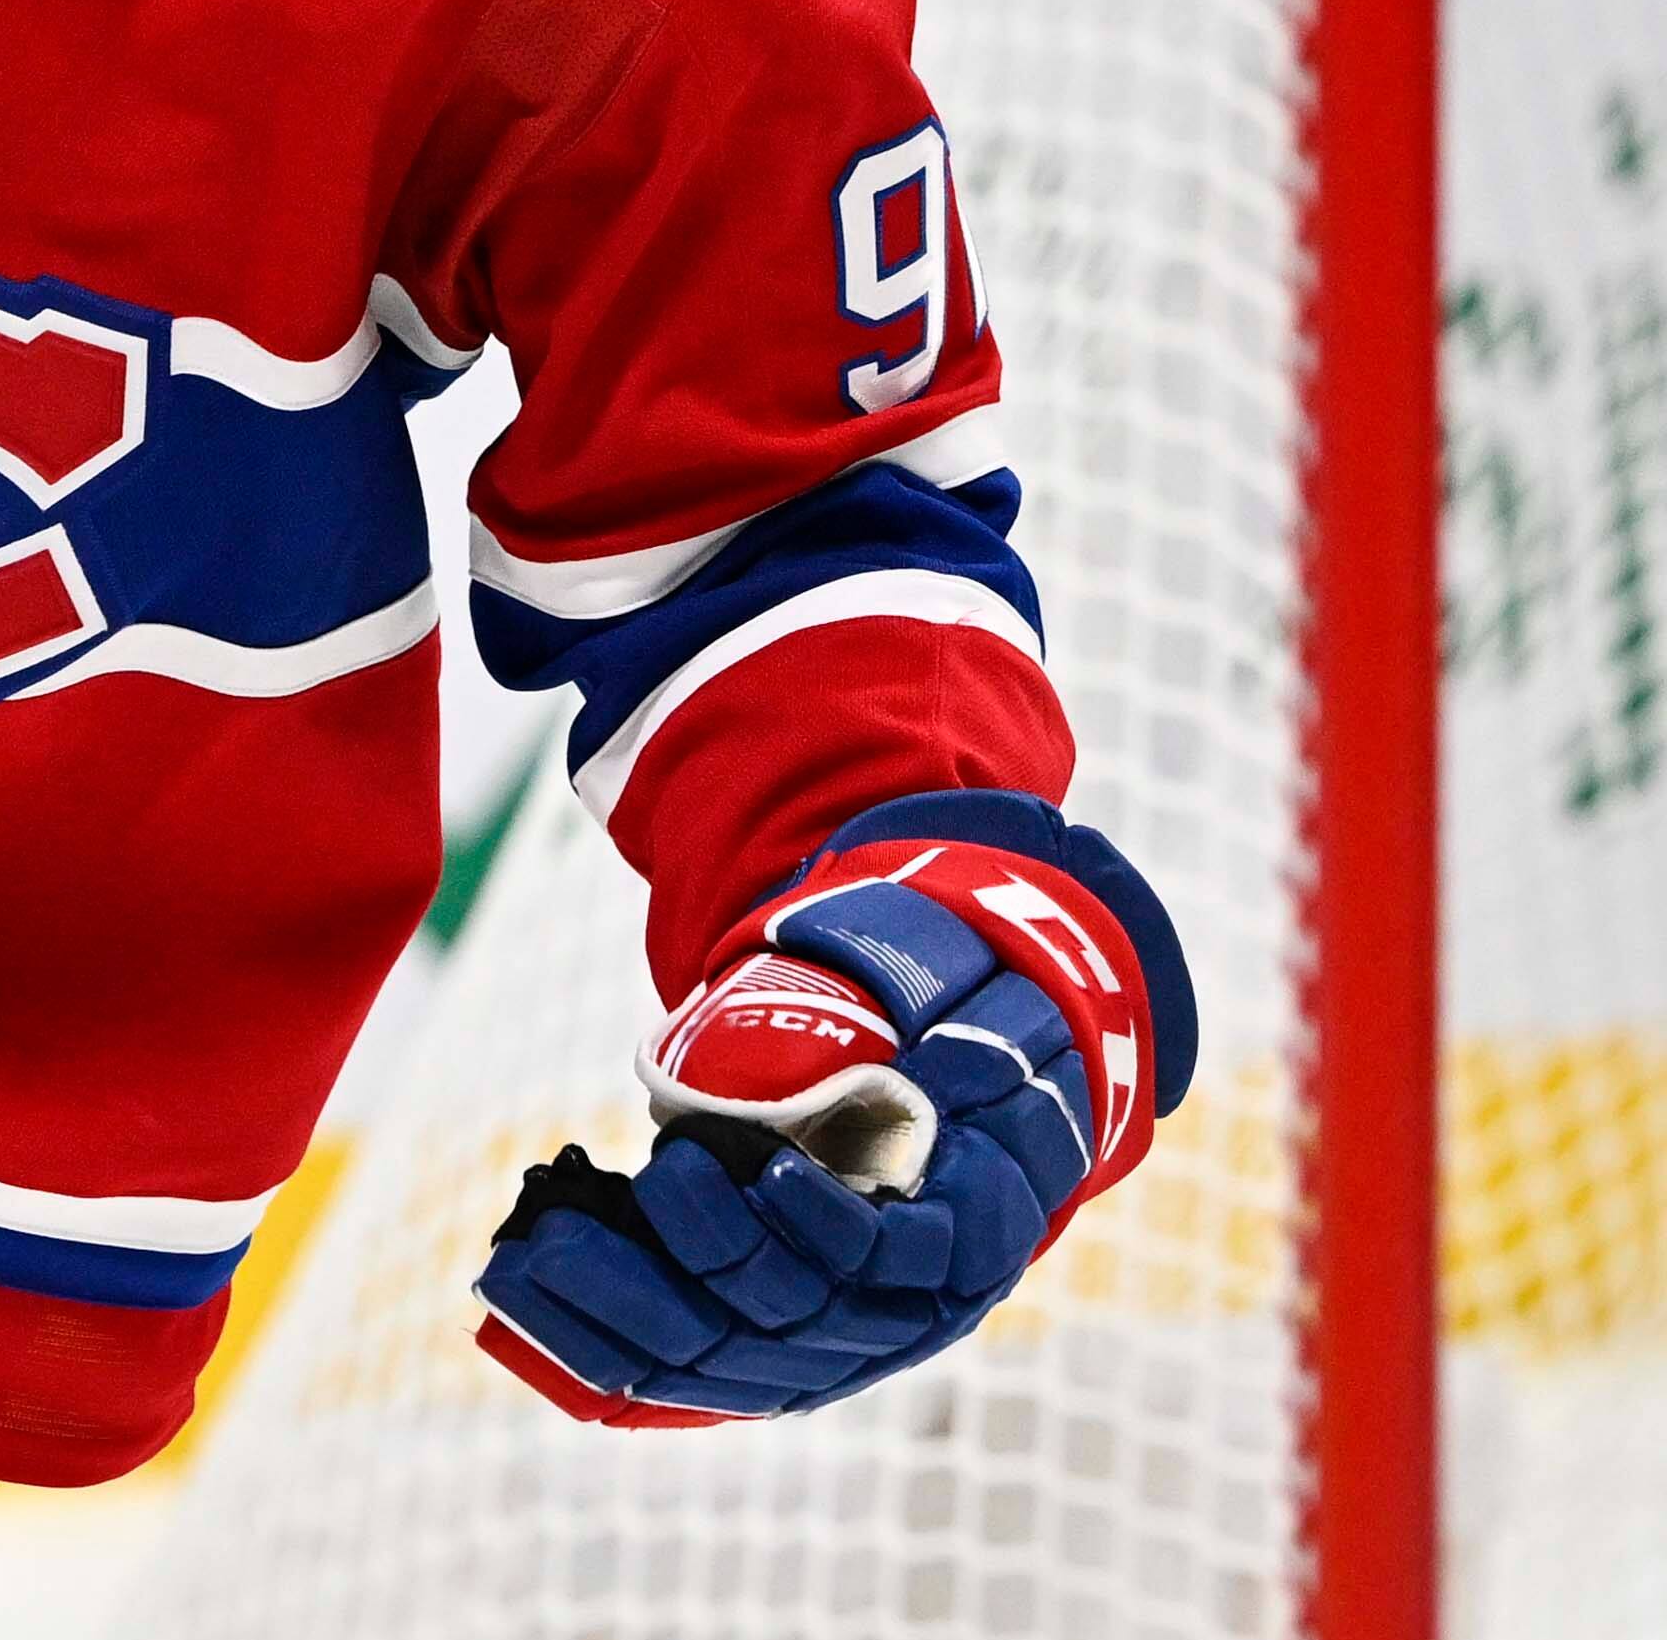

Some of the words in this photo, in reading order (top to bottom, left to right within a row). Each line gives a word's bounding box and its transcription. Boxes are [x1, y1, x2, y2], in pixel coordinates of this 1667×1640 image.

[831, 115, 989, 415] 9
[724, 1009, 856, 1047] CCM
[972, 870, 1139, 1163] CC
